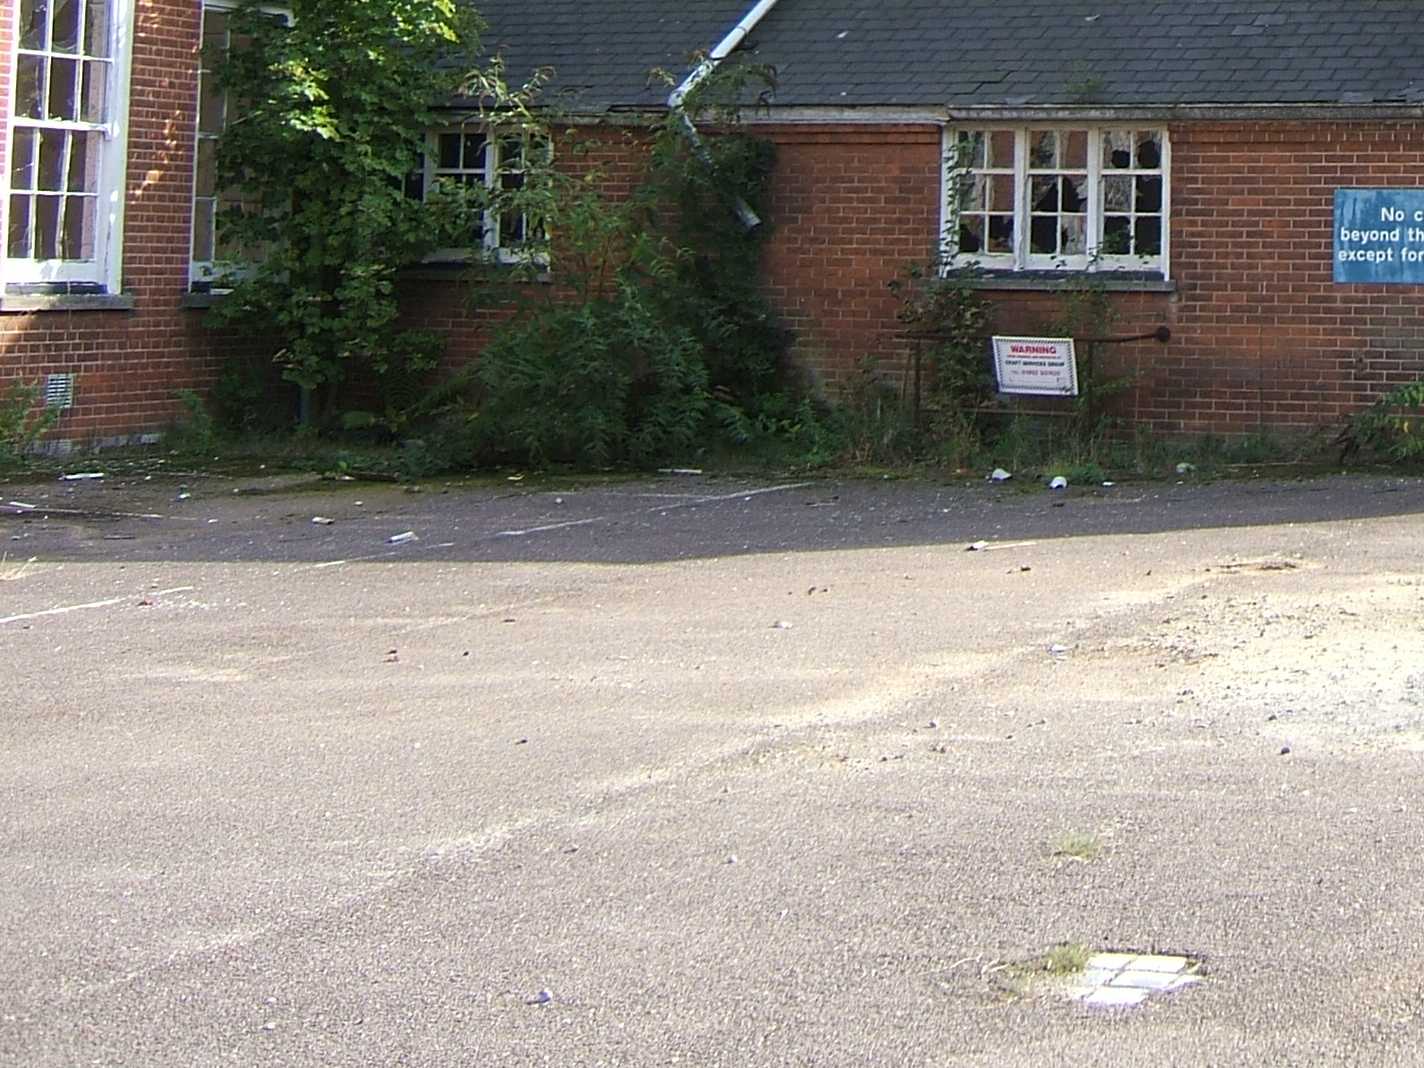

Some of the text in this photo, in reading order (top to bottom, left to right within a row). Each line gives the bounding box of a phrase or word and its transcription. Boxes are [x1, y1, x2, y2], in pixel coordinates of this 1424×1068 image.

[1380, 207, 1405, 222] No
[1340, 227, 1400, 244] beyond
[1338, 247, 1393, 263] except
[1401, 247, 1424, 262] for
[1010, 345, 1057, 354] WARNING
